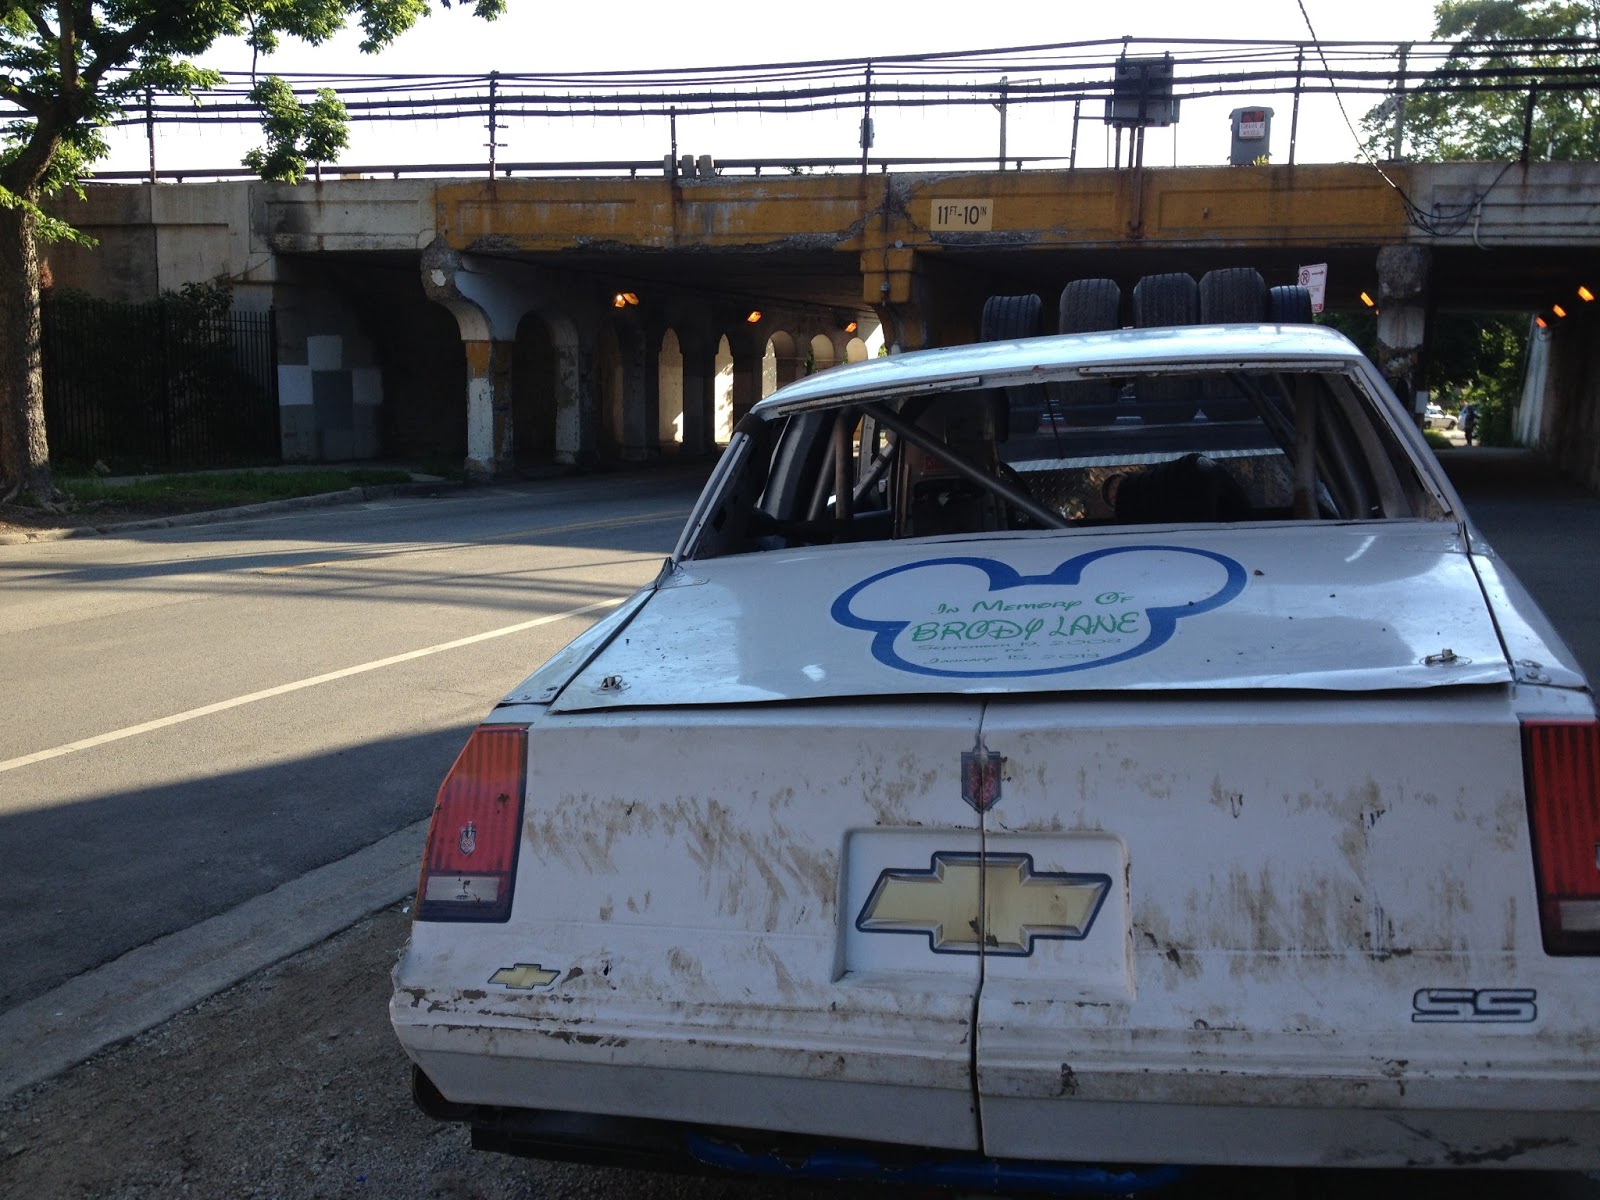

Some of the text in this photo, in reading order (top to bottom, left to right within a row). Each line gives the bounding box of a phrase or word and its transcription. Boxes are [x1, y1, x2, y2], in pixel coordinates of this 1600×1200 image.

[931, 602, 960, 615] In
[972, 599, 1082, 613] Memory
[911, 611, 1140, 642] BRODY LANE
[1411, 988, 1537, 1023] SS
